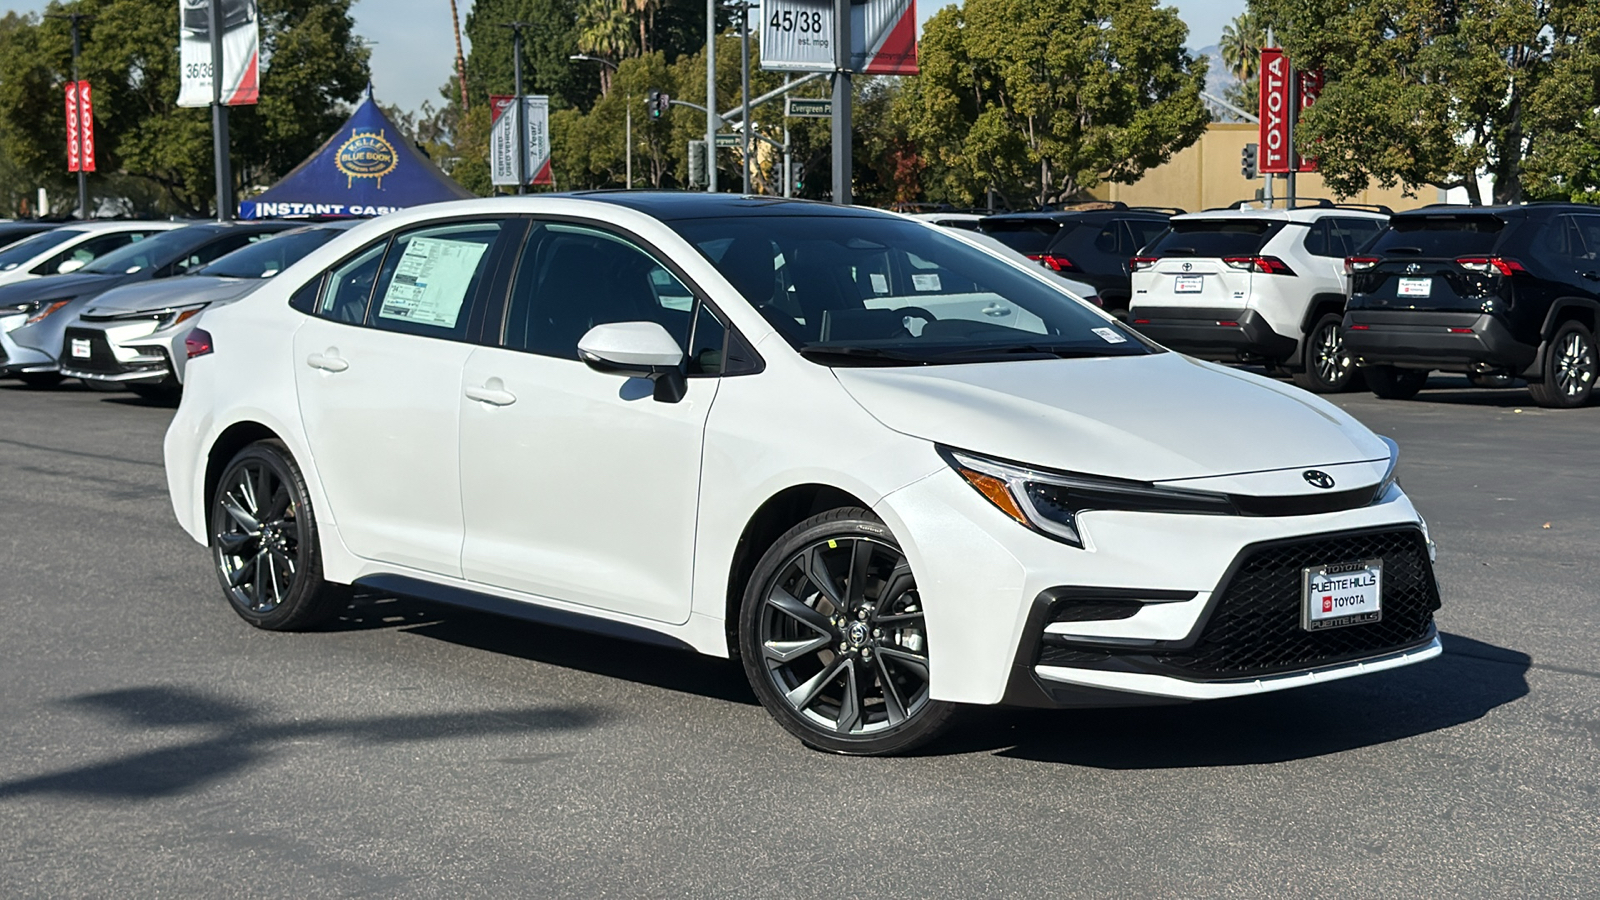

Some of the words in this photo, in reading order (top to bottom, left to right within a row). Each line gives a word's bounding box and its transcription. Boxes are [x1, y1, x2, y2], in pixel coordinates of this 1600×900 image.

[770, 10, 822, 34] 45/38
[798, 38, 812, 46] est.
[813, 38, 829, 47] mpg
[791, 103, 823, 114] Evergreen
[1267, 57, 1282, 167] TOYOTA
[67, 88, 79, 167] TOYOTA
[82, 87, 93, 167] TOYOTA
[342, 152, 365, 161] BLUE
[366, 152, 391, 162] BOOK
[256, 202, 344, 217] INSTANT
[1327, 563, 1365, 573] TOYOTA
[1311, 579, 1348, 593] PUENTE
[1350, 576, 1376, 588] HILLS
[1334, 595, 1365, 608] TOYOTA
[1312, 617, 1349, 629] PUENTE
[1351, 613, 1378, 623] HILLS
